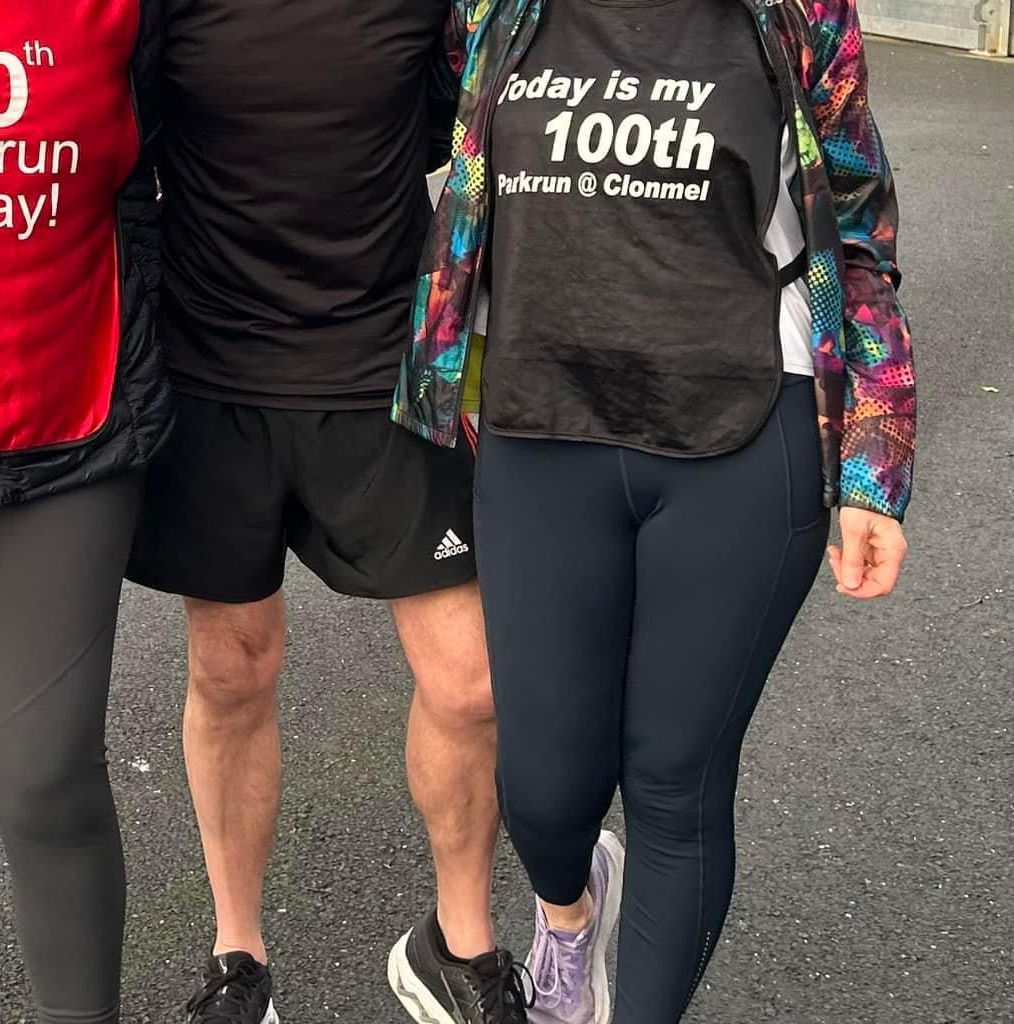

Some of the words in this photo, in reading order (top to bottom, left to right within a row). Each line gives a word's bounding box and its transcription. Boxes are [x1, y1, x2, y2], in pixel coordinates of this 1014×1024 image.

[602, 69, 640, 102] is
[650, 78, 716, 112] my
[544, 110, 715, 171] 100th
[497, 170, 572, 197] Parkrun
[577, 171, 598, 198] @
[602, 171, 711, 202] Clonmel
[433, 543, 469, 561] adidas
